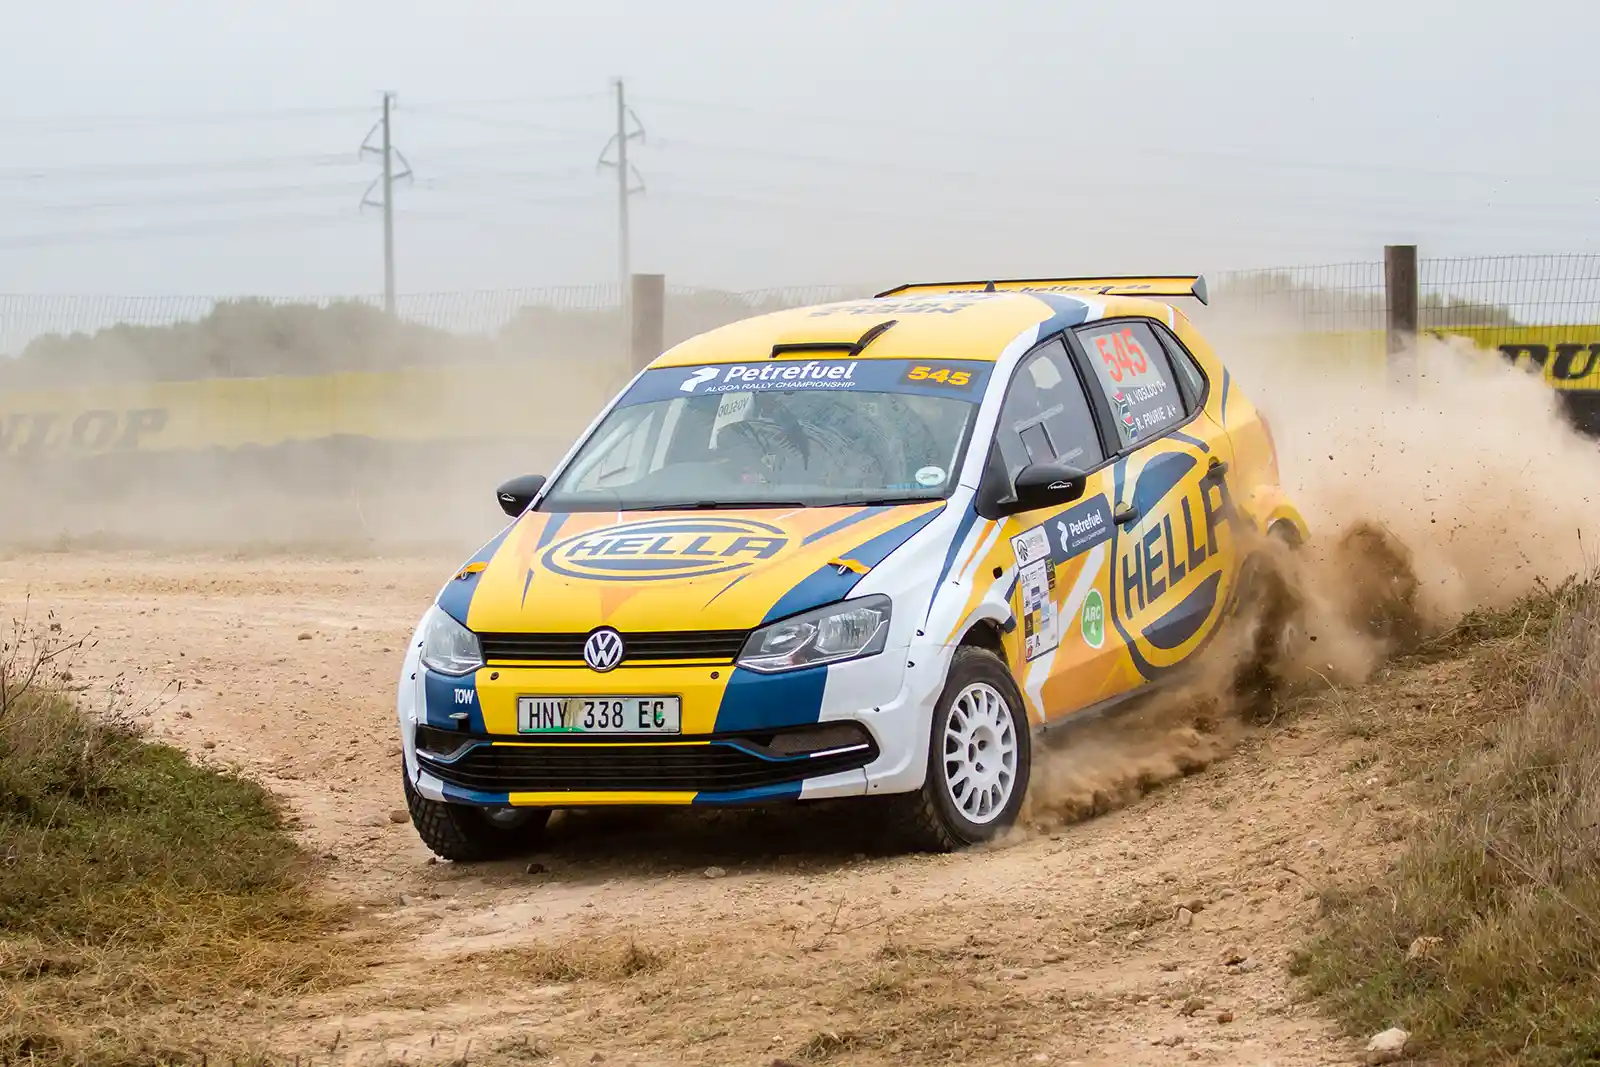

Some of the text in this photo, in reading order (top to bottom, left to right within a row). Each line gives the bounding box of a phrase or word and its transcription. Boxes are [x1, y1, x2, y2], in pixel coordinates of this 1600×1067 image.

[1095, 328, 1148, 383] 545
[723, 361, 858, 383] Petrefuel
[908, 366, 973, 386] 545
[705, 380, 857, 393] ALGOA RALLY CHAMPIONSHIP
[1142, 407, 1166, 428] FOURIE
[1069, 509, 1103, 537] Petrefuel
[564, 536, 789, 559] HELLA
[1122, 472, 1239, 621] HELLA
[1084, 605, 1101, 622] ARC
[1090, 622, 1098, 636] 4
[454, 688, 474, 705] TOW
[529, 701, 666, 729] HNY 338 EC
